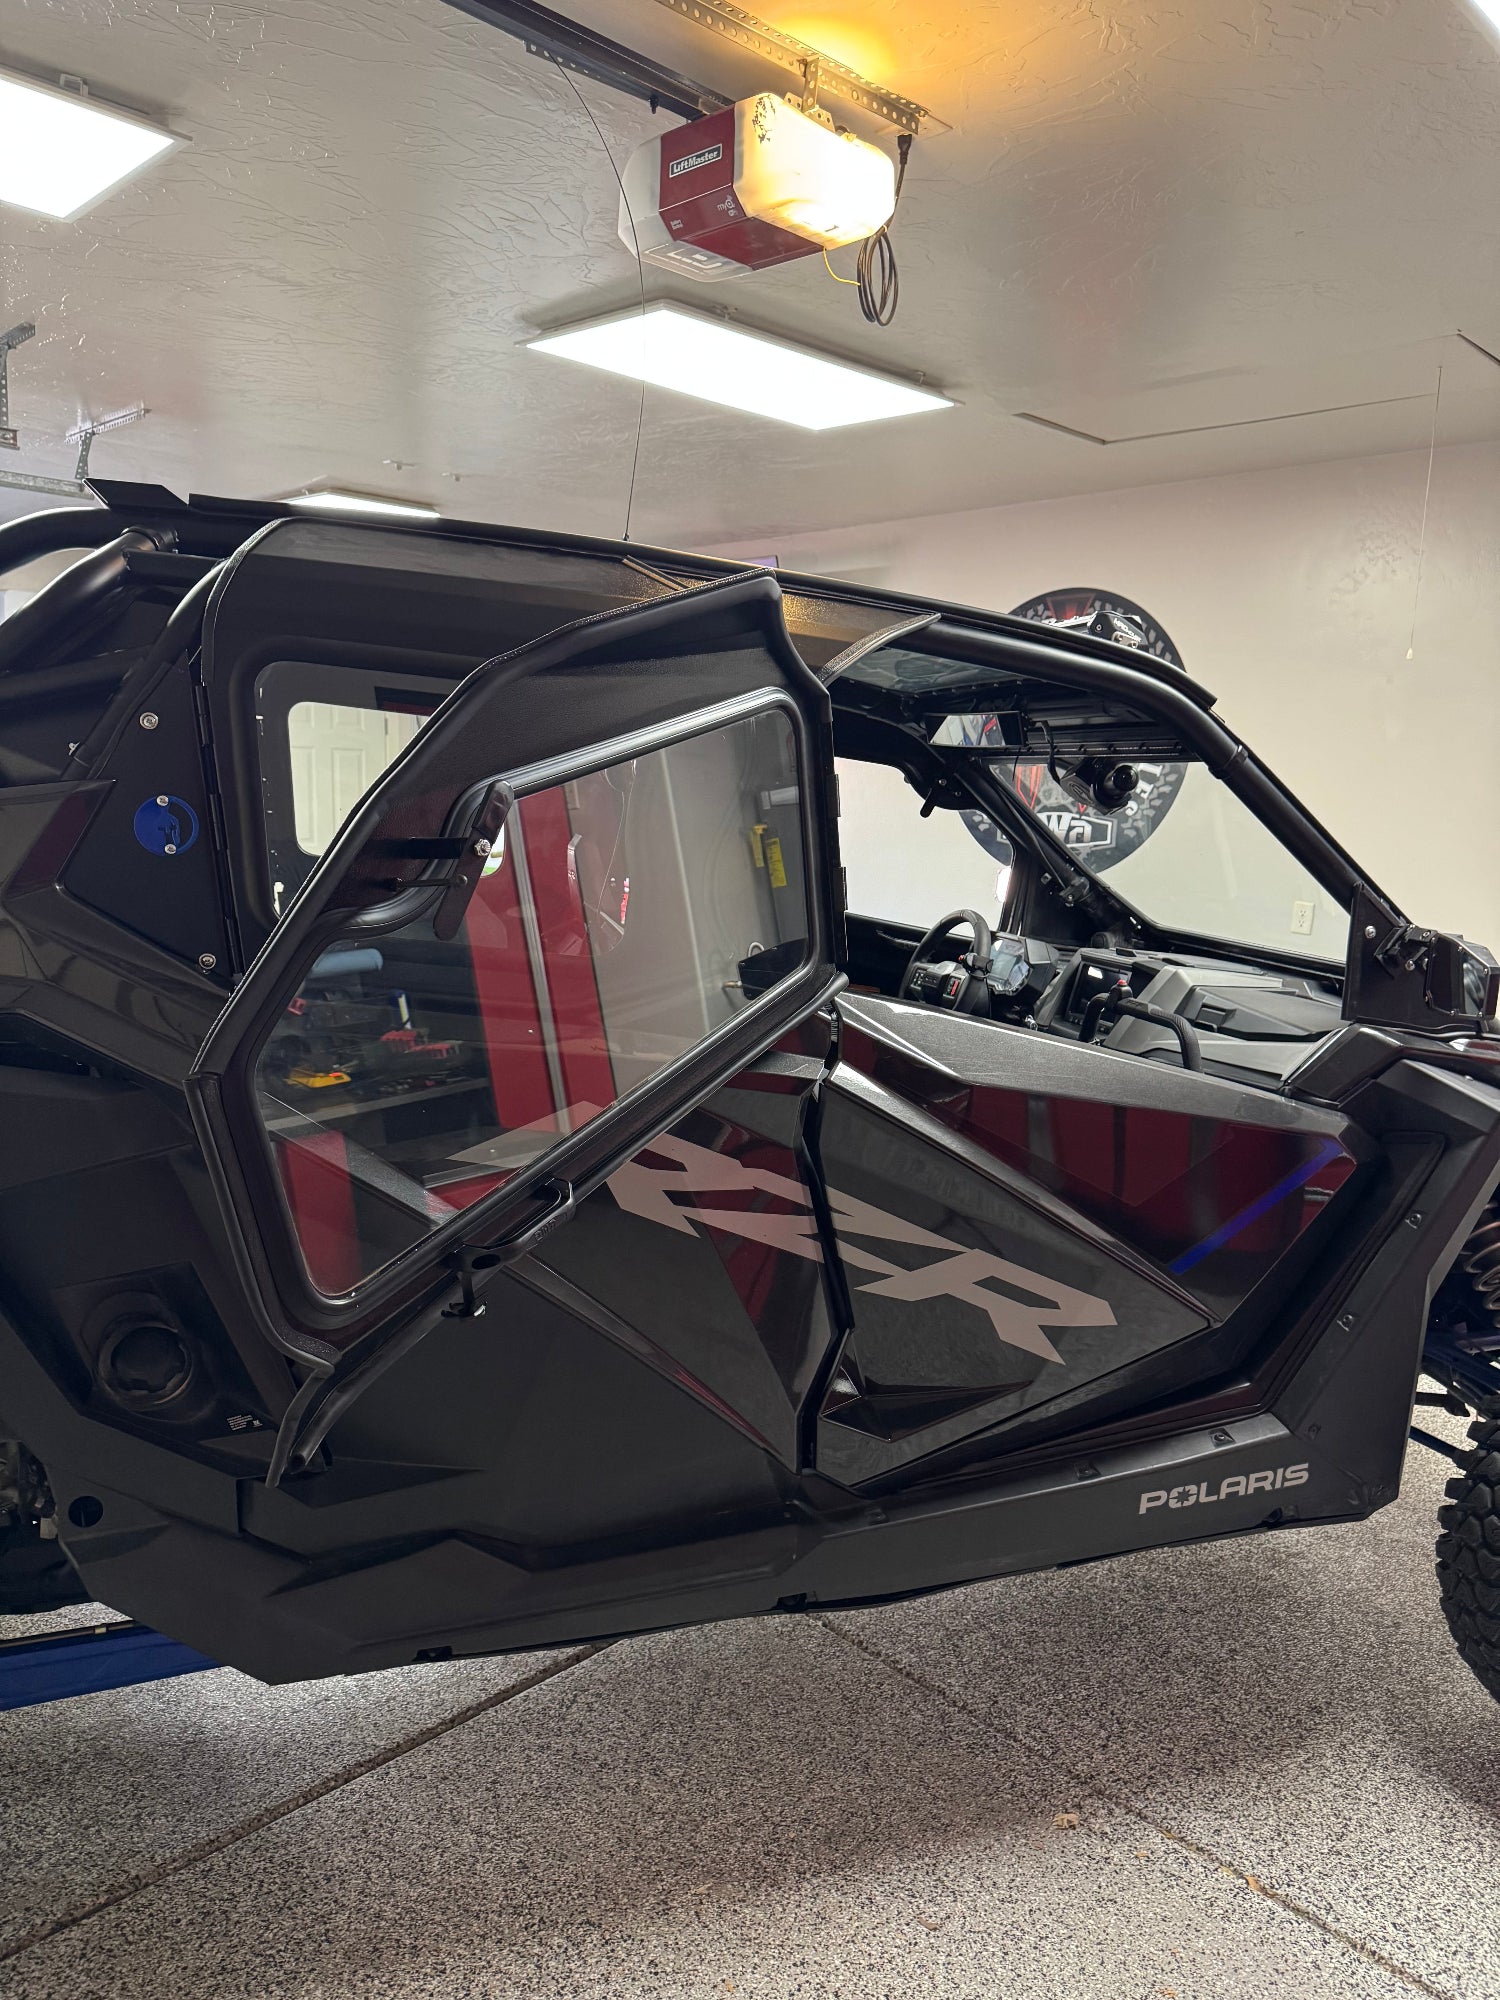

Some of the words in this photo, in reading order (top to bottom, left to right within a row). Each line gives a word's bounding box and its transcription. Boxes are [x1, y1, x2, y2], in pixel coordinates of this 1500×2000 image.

[673, 150, 718, 173] LiftMaster
[446, 1101, 1118, 1364] RZR
[1138, 1463, 1309, 1515] POLARIS
